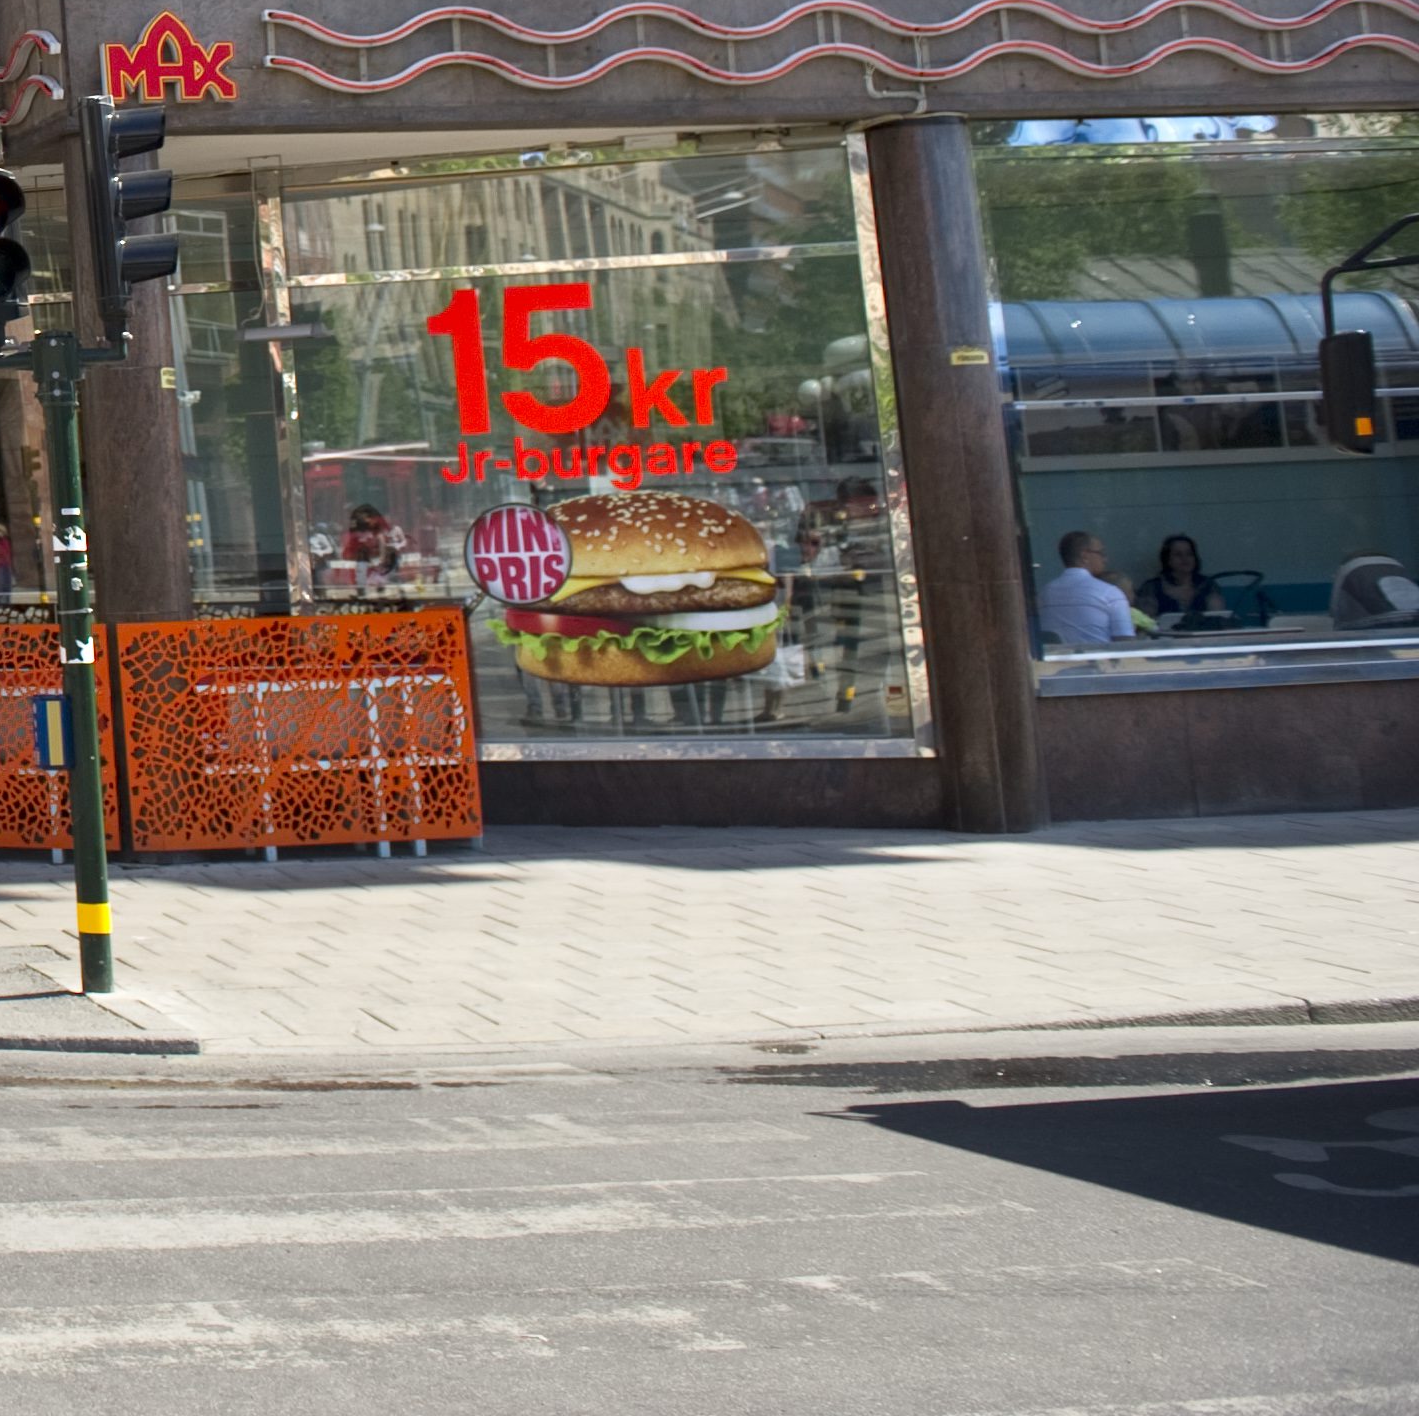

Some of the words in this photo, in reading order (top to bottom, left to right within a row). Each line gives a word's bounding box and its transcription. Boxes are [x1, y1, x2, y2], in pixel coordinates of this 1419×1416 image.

[103, 9, 239, 103] MAX
[426, 281, 612, 436] 15
[626, 346, 729, 429] kr
[441, 436, 739, 491] Jr-burgare
[472, 506, 563, 554] MINI
[473, 553, 565, 601] PRIS
